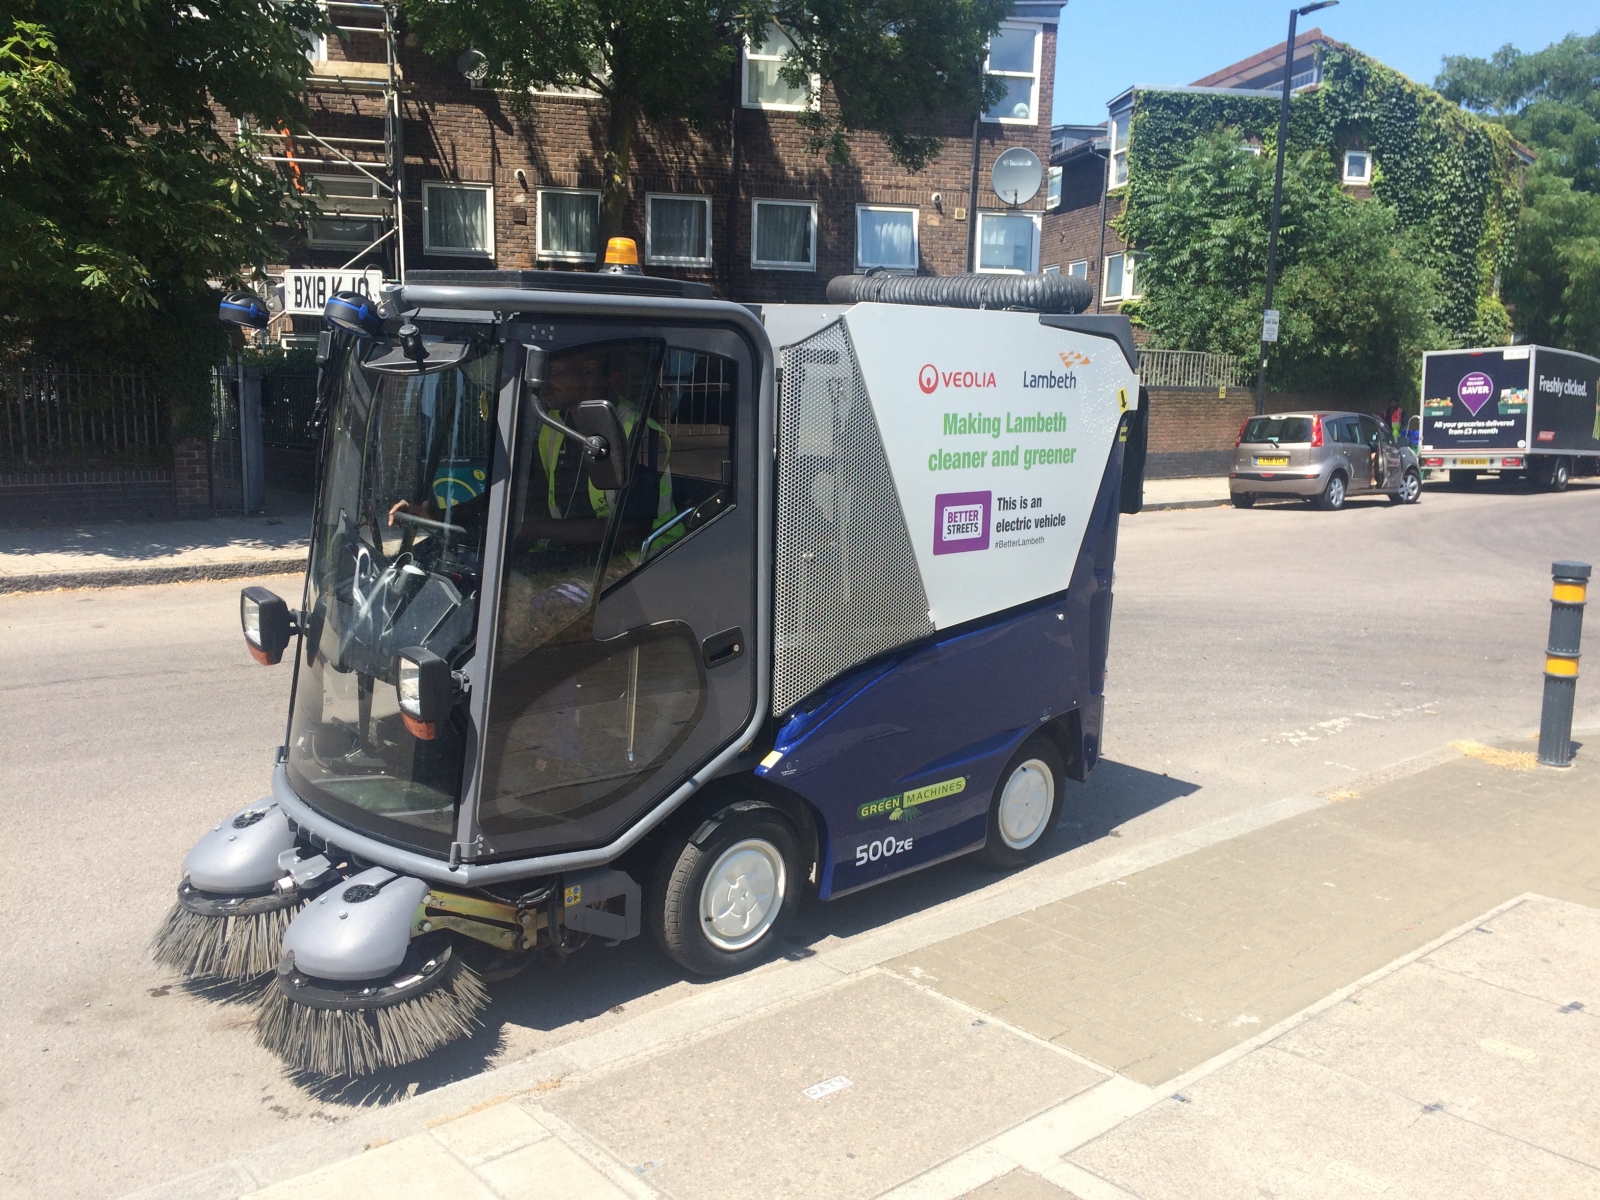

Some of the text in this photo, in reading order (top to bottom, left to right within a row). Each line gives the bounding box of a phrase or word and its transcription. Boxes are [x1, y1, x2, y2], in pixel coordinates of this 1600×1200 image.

[942, 371, 997, 388] VEOLIA
[1023, 370, 1077, 389] Lambeth
[1539, 375, 1588, 398] Freshly clicked.
[1461, 386, 1490, 395] SAVER
[943, 412, 1067, 439] Making Lambeth
[1443, 422, 1457, 430] your
[1457, 420, 1485, 429] groceries
[1485, 419, 1515, 427] delivered
[1477, 427, 1499, 435] month
[928, 445, 1077, 472] cleaner and greener
[997, 496, 1042, 511] This is an
[947, 510, 979, 523] BETTER
[996, 513, 1066, 533] electric vehicle
[947, 522, 979, 535] STREETS
[994, 536, 1045, 549] #BetterLambeth
[861, 780, 962, 817] GREEN MACHINES
